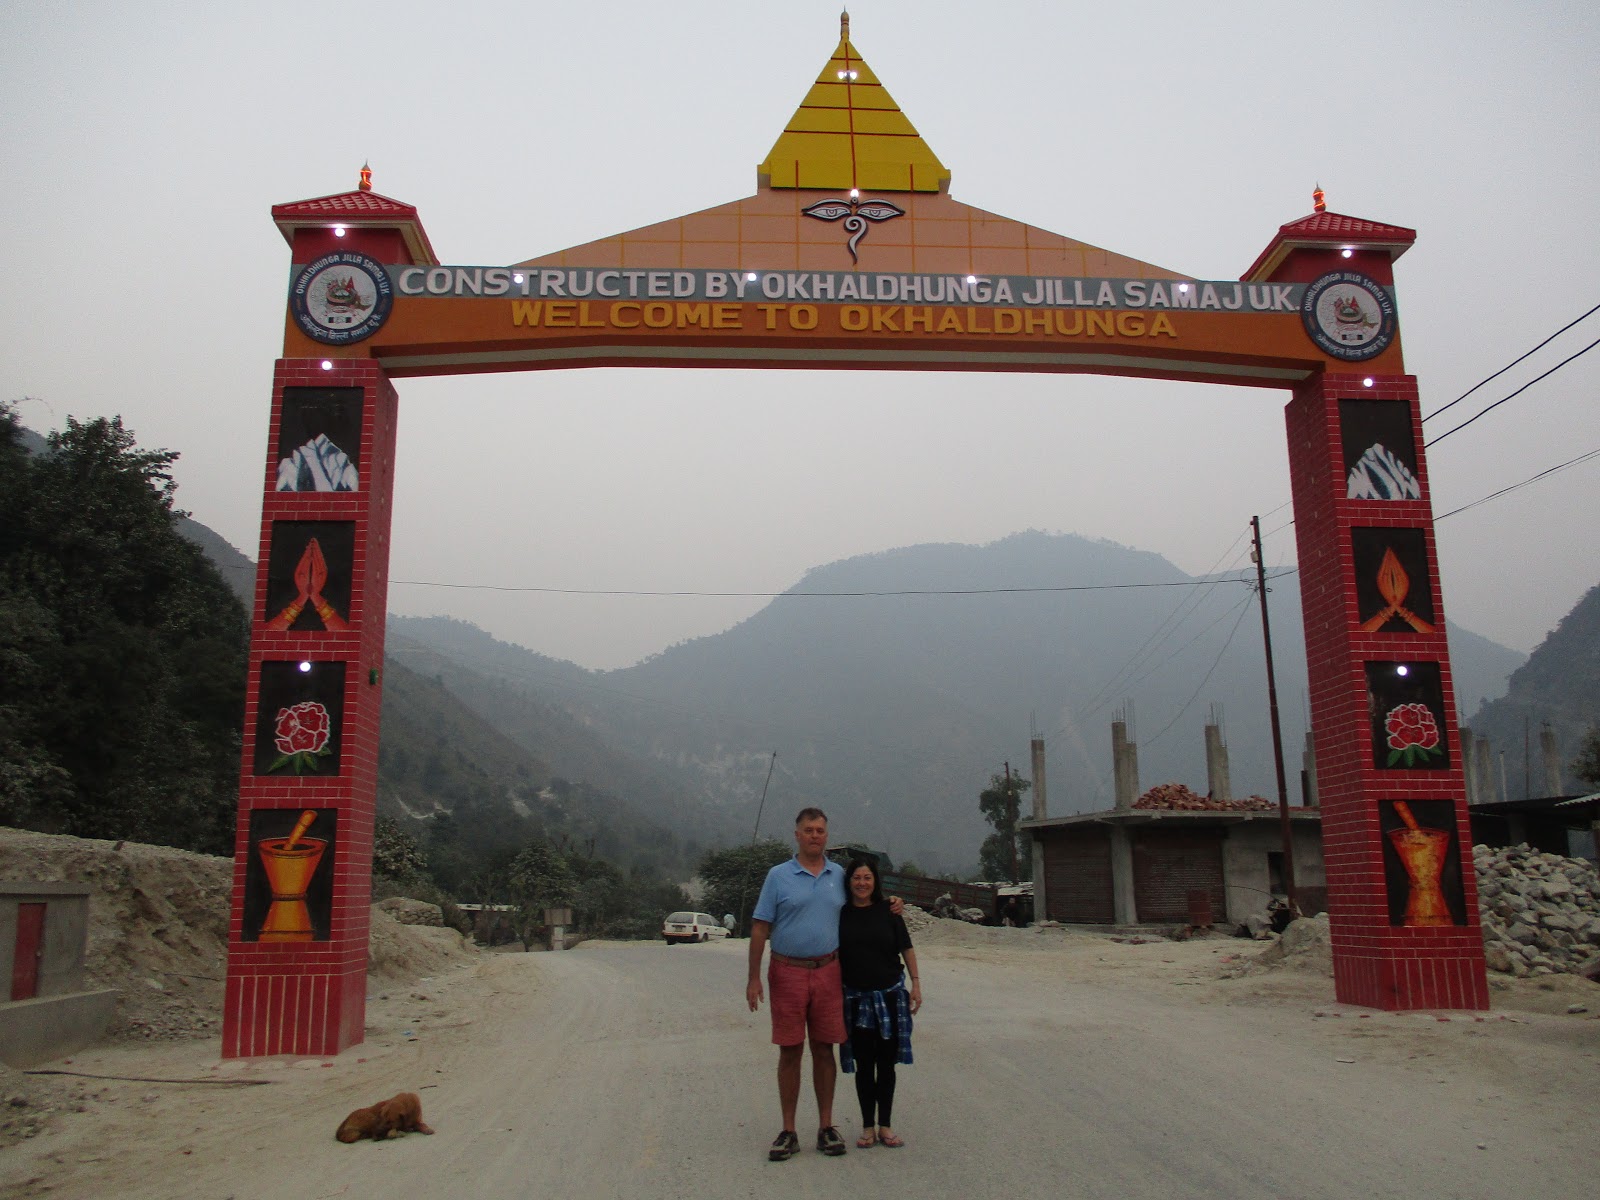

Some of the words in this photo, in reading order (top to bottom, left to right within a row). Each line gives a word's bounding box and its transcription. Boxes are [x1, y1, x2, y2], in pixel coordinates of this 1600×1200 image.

[399, 268, 696, 298] CONSTRUCTED
[705, 272, 748, 298] BY
[761, 273, 1014, 304] OKHALDHUNGA
[1022, 279, 1117, 307] JILLA
[1124, 281, 1244, 310] SAMAJ
[1248, 284, 1300, 311] U.K.
[510, 300, 744, 329] WELCOME
[756, 303, 819, 330] TO
[839, 305, 1178, 338] OKHALDHUNGA
